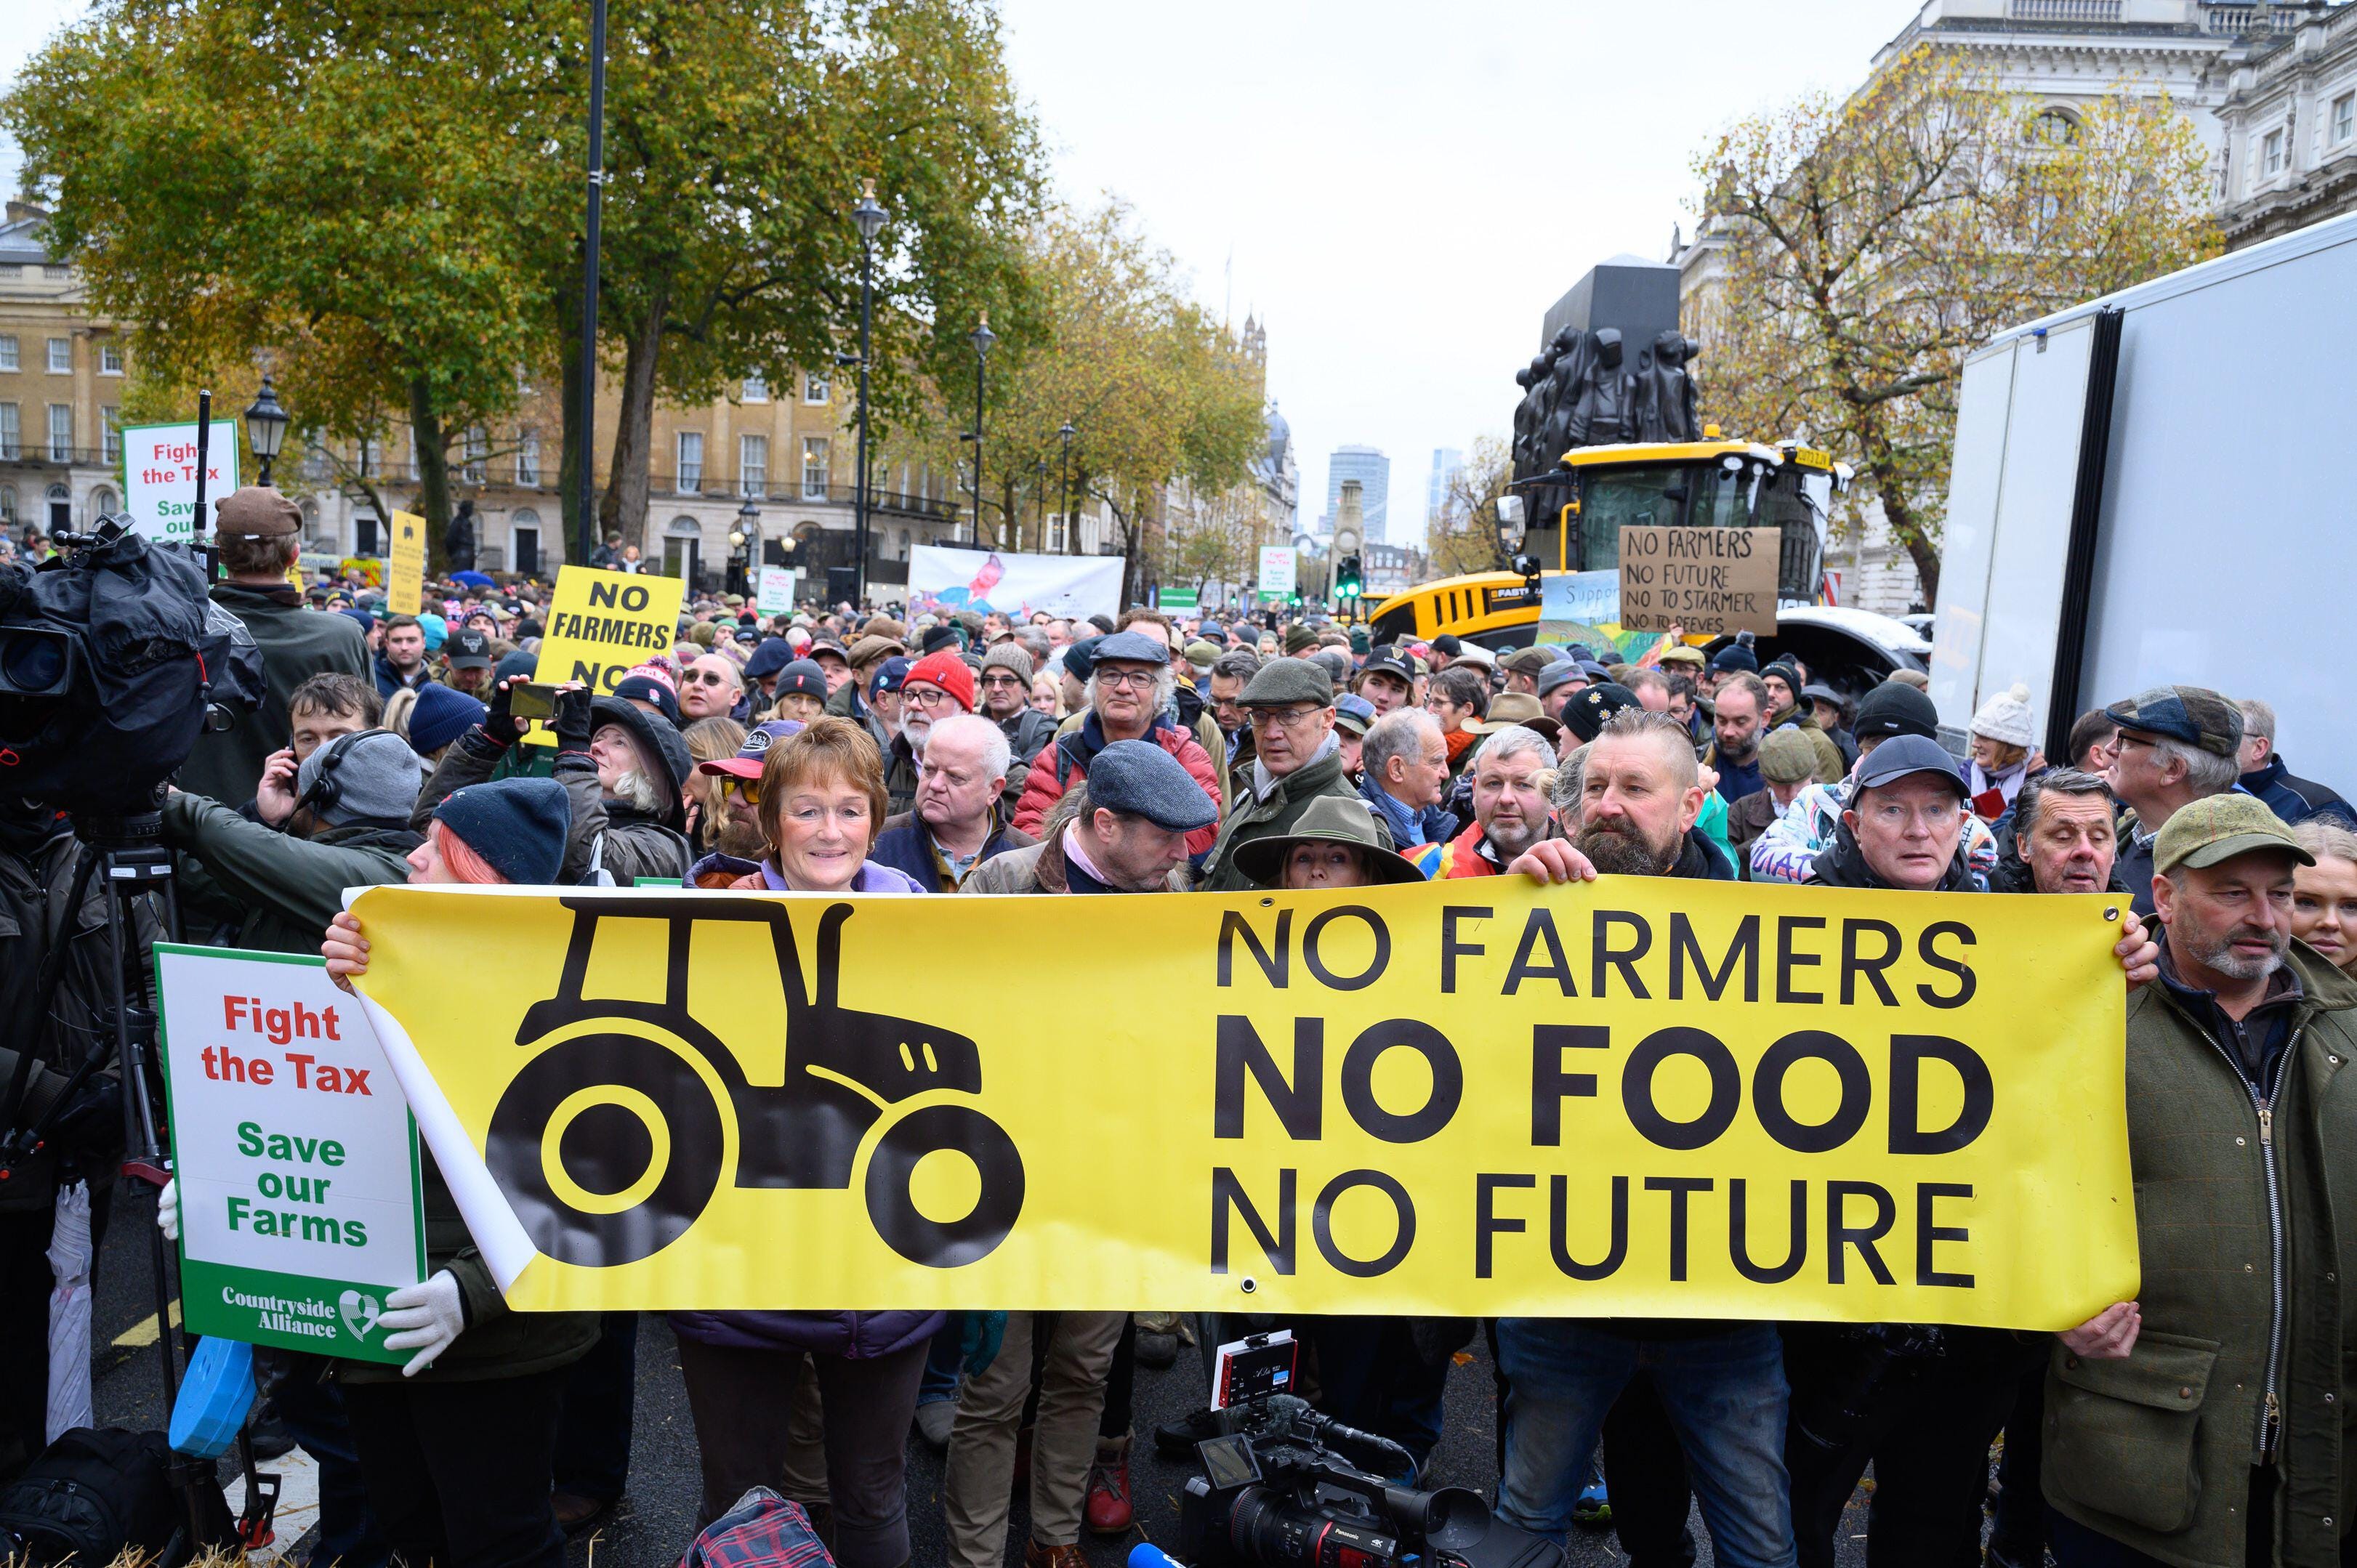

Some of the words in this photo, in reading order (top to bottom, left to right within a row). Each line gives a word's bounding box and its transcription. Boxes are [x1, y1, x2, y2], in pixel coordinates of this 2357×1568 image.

[154, 443, 198, 463] Figh
[142, 468, 175, 484] the
[158, 500, 196, 516] Sav
[166, 521, 196, 533] ou
[1627, 532, 1658, 557] NO
[1669, 530, 1753, 559] FARMERS
[1627, 565, 1654, 584] NO
[1664, 564, 1731, 590] FUTURE
[589, 581, 649, 612] NO
[1566, 586, 1620, 607] Suppor
[1626, 591, 1651, 607] NO
[1660, 589, 1679, 609] TO
[1683, 589, 1758, 613] STARMER
[552, 613, 669, 650] FARMERS
[1626, 614, 1649, 629] NO
[1656, 614, 1670, 628] TO
[571, 660, 629, 691] NO
[1216, 906, 1390, 990] NO
[1442, 906, 1976, 1009] FARMERS
[225, 995, 341, 1044] Fight
[201, 1046, 274, 1085] the
[286, 1053, 373, 1096] Tax
[1214, 1016, 1462, 1143] NO
[1531, 1025, 1994, 1155] FOOD
[237, 1122, 345, 1166] Save
[257, 1172, 331, 1205] our
[227, 1196, 368, 1247] Farms
[1212, 1168, 1416, 1277] NO
[1476, 1173, 1974, 1288] FUTURE
[222, 1286, 336, 1320] Countryside
[258, 1310, 337, 1338] Alliance
[1334, 1528, 1359, 1540] Panasonic
